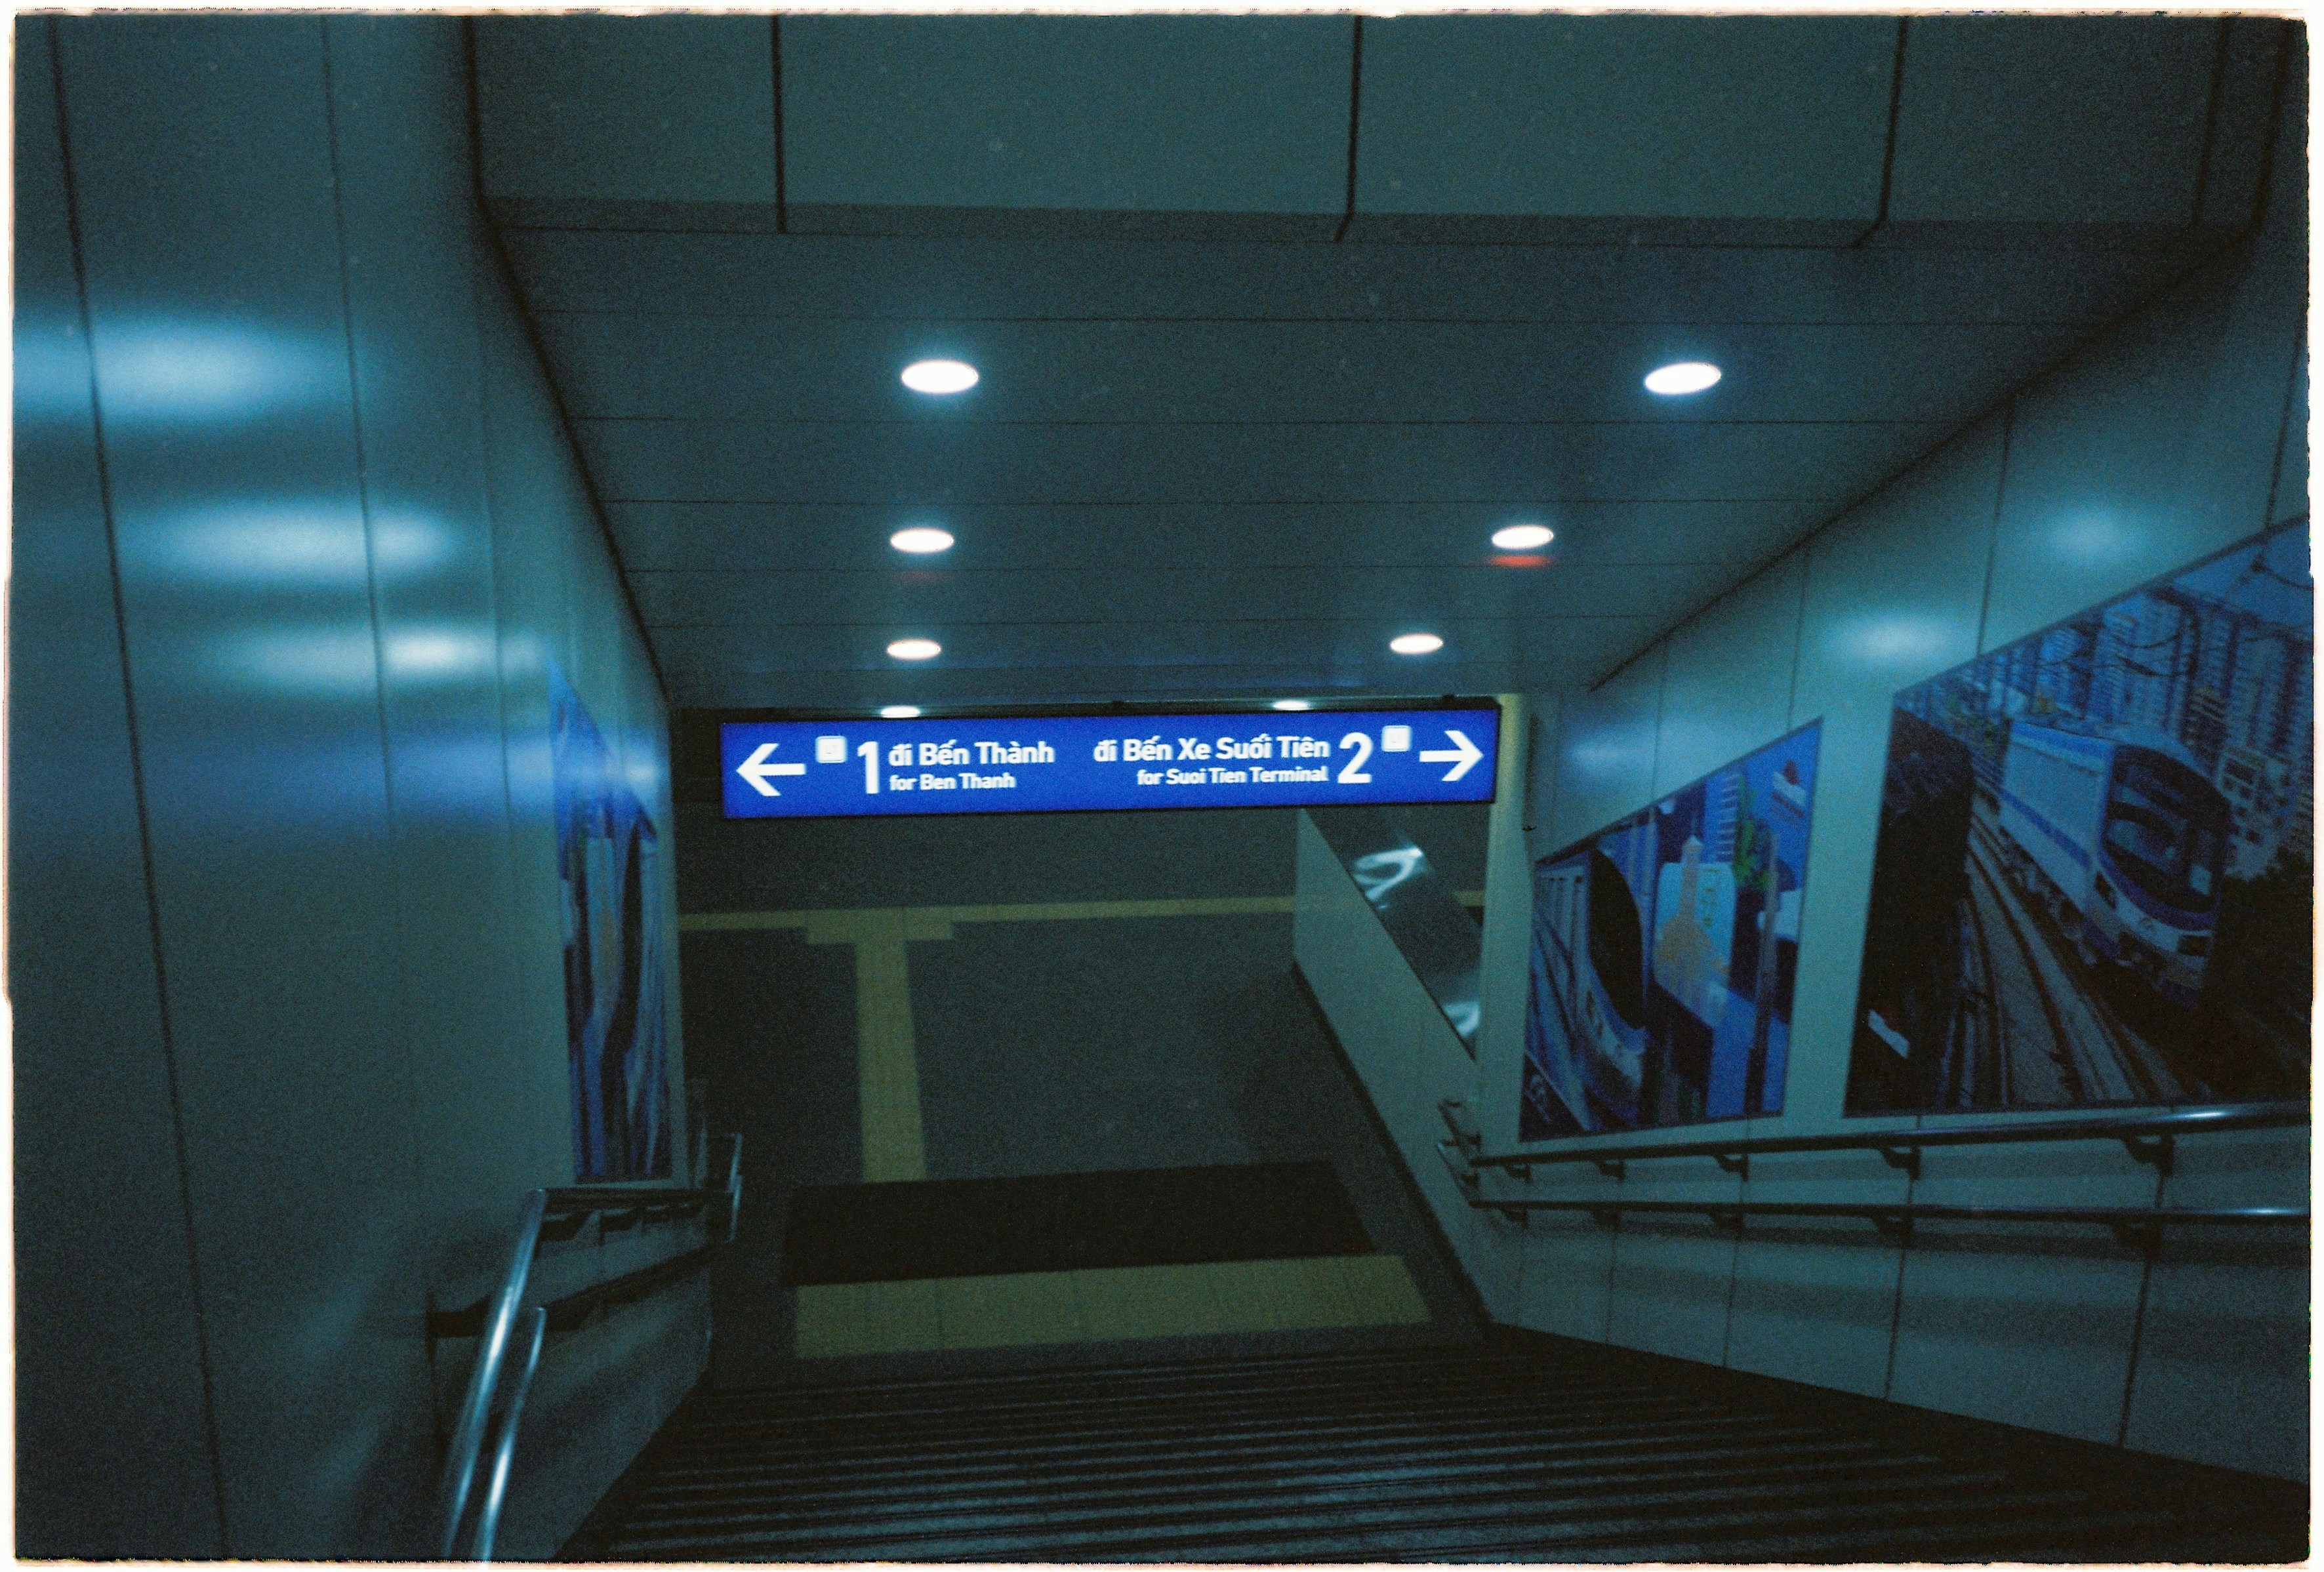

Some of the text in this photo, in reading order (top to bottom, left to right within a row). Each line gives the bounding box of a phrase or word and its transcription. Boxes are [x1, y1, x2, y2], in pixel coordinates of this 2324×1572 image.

[889, 740, 1054, 766] đi Bến Thành
[1094, 734, 1330, 761] đi Bến Xe Suối Tiên
[1338, 733, 1372, 784] 2
[858, 741, 878, 794] 1
[1137, 766, 1328, 784] for Suoi Tien Terminal
[889, 773, 1015, 790] for Ben Thanh
